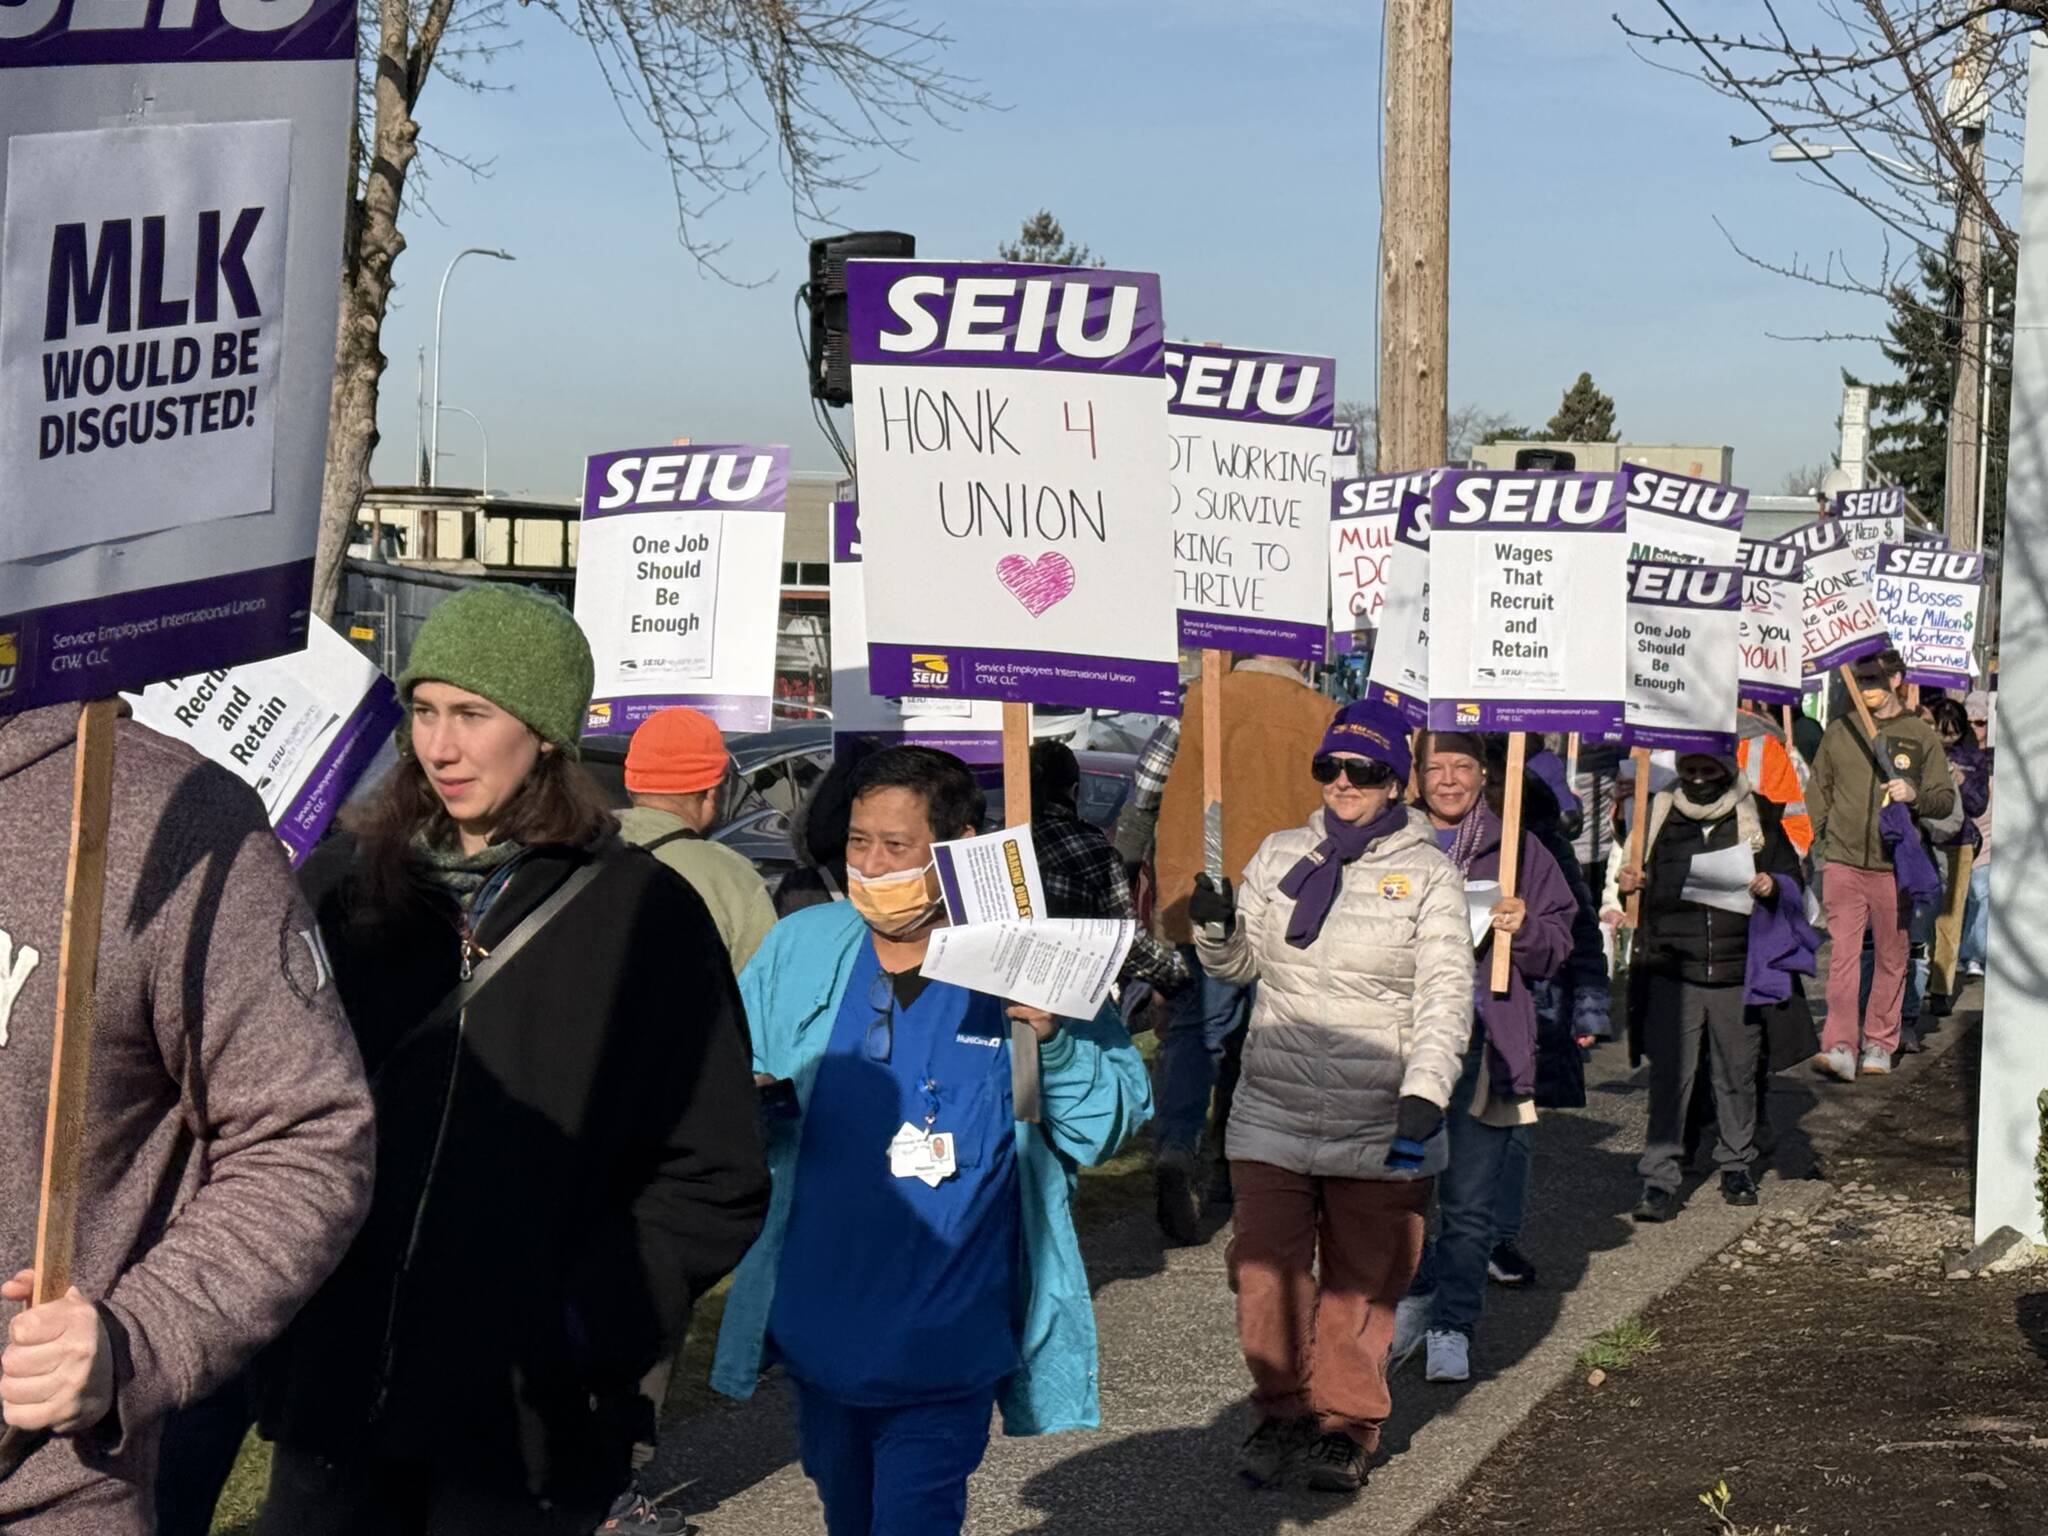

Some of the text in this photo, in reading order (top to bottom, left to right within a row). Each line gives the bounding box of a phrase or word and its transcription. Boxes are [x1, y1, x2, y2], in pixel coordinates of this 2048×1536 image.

[44, 206, 265, 341] MLK
[879, 275, 1139, 358] SEIU
[43, 328, 260, 402] WOULD BE
[39, 386, 257, 460] DISGUSTED!
[880, 386, 1096, 460] HONK 4
[1213, 440, 1326, 487] WORKING
[598, 454, 773, 509] SEIU
[1195, 487, 1302, 529] SURVIVE
[1450, 477, 1614, 524] SEIU
[1626, 472, 1738, 521] SEIU
[1842, 491, 1898, 517] SEIU
[939, 481, 1106, 542] UNION
[632, 533, 709, 554] One Job
[1174, 530, 1290, 572] KING TO
[1339, 526, 1393, 552] MUL
[1780, 522, 1835, 556] IU
[1494, 543, 1553, 565] Wages
[1735, 543, 1796, 576] EIU
[1885, 549, 1976, 579] SEIU
[636, 560, 701, 581] Should
[1503, 568, 1542, 586] That
[1627, 564, 1732, 604] EIU
[655, 588, 680, 606] Be
[1490, 592, 1554, 612] Recruit
[1876, 578, 1962, 609] Big Bosses
[52, 598, 266, 649] Service Employees International Union
[631, 613, 699, 637] Enough
[1505, 617, 1537, 634] and
[1634, 621, 1691, 640] One Job
[1880, 607, 1918, 626] Make
[1638, 639, 1685, 656] Should
[1757, 624, 1791, 644] you
[1909, 627, 1964, 645] Workers
[86, 648, 109, 666] CLC
[1492, 640, 1548, 659] Retain
[911, 672, 949, 684] SEIU
[975, 662, 1136, 683] Service Employees International Union
[1652, 658, 1669, 672] Be
[1634, 673, 1685, 693] Enough
[174, 668, 231, 728] Recru
[218, 684, 251, 732] and
[230, 696, 287, 766] Retain
[1002, 840, 1025, 885] SHARING
[1013, 885, 1030, 908] OUR
